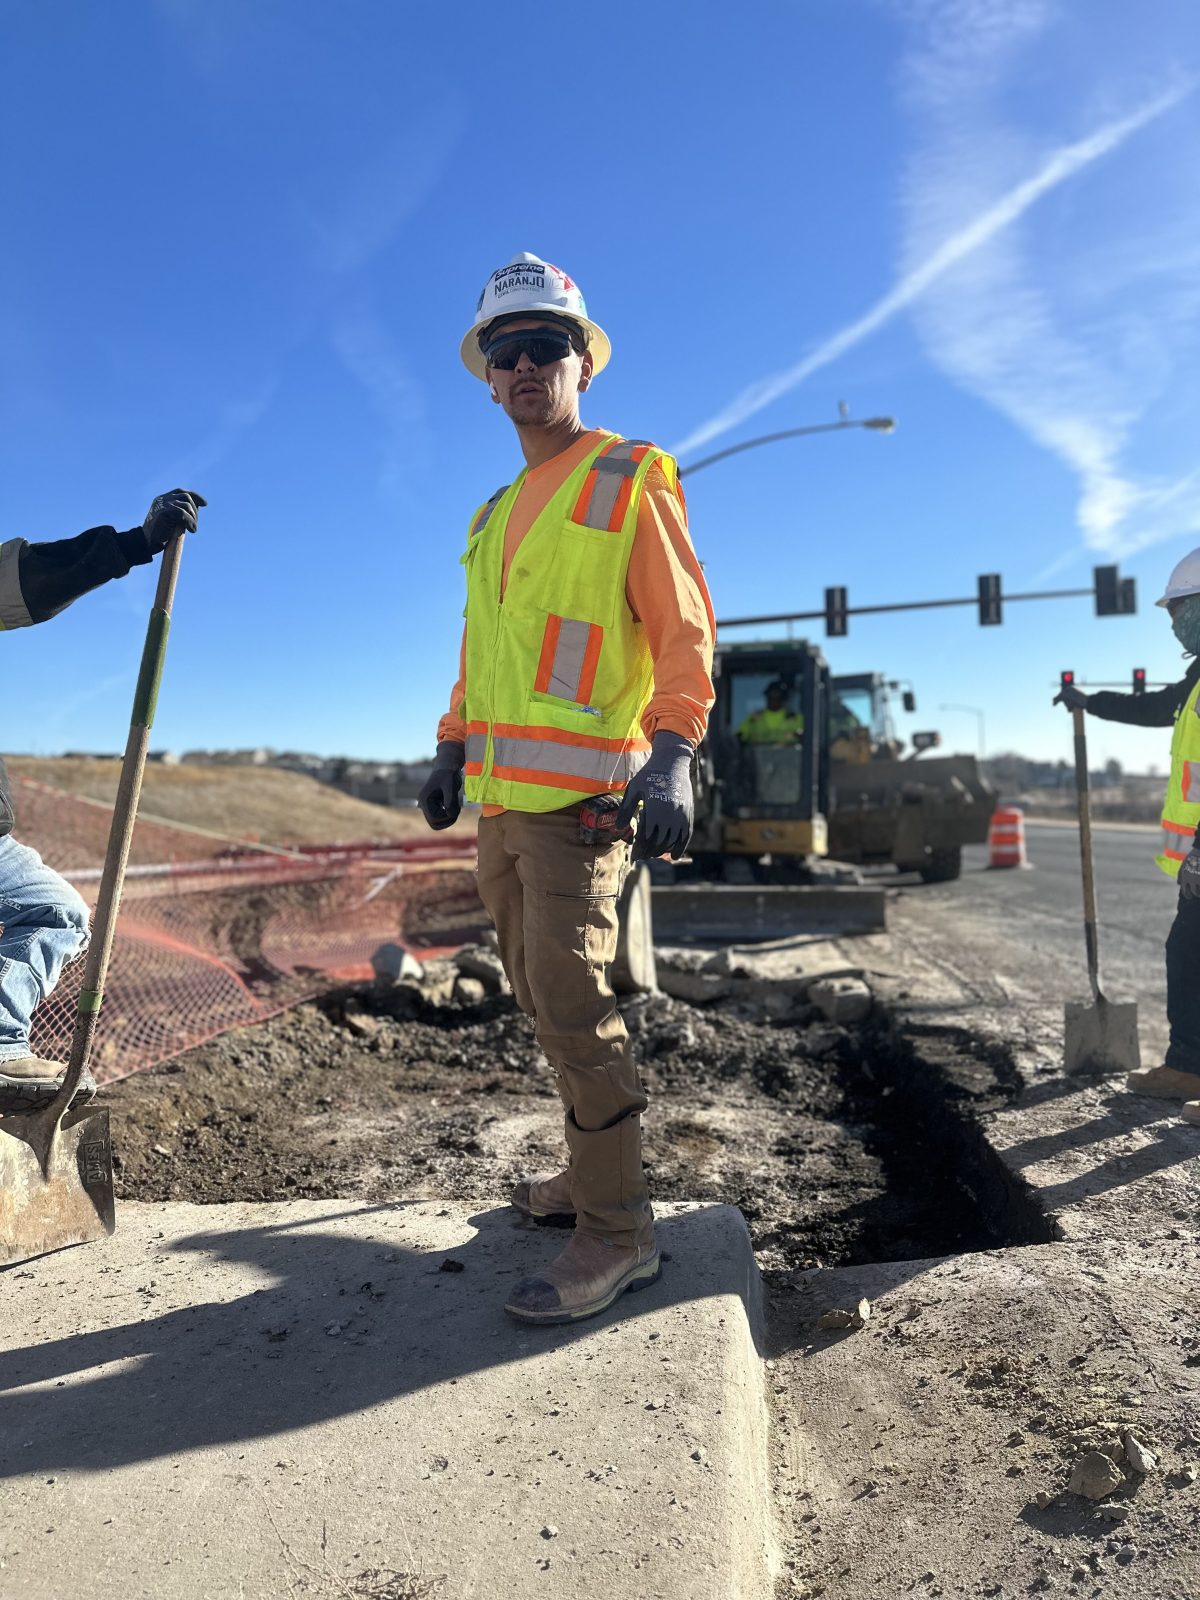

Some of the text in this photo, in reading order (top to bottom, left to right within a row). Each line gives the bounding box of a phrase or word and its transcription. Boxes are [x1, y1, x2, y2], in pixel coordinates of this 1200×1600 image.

[495, 264, 544, 279] Supreme
[495, 276, 545, 295] NARANJO
[88, 1146, 100, 1181] AMES
